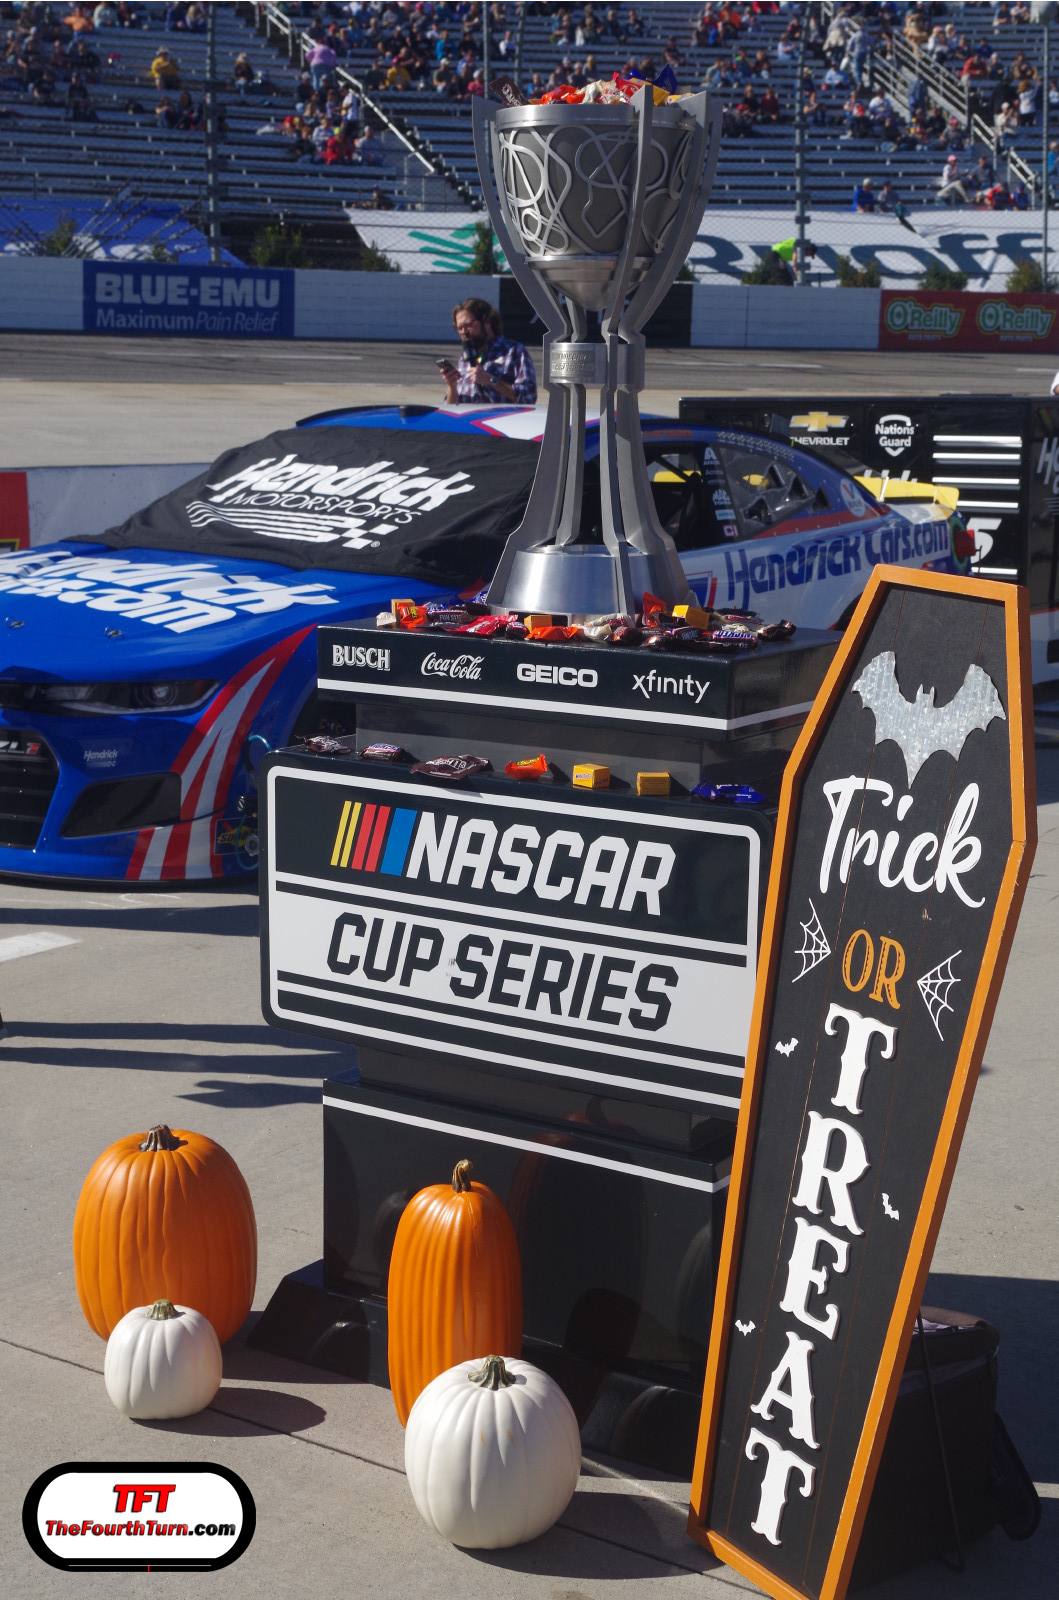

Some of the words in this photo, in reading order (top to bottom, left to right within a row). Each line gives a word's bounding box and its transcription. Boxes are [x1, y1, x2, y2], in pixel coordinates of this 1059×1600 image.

[95, 273, 280, 308] BLUE-EMU
[96, 309, 193, 330] Maximum
[195, 311, 232, 331] Pain
[234, 312, 279, 332] Relief
[889, 303, 961, 333] O'Reilly
[982, 304, 1053, 335] O'Reilly
[875, 424, 914, 435] Nations
[879, 436, 911, 447] Guard
[206, 454, 475, 511] Hendrick
[230, 493, 421, 524] MOTORSPORTS
[332, 644, 391, 672] BUSCH
[420, 651, 485, 680] Coca-Cola
[516, 663, 598, 688] GEICO
[632, 669, 710, 703] xfinity
[84, 749, 118, 762] Hendrick
[819, 775, 985, 908] Trick
[406, 811, 676, 916] NASCAR
[327, 912, 445, 987] CUP
[449, 934, 679, 1032] SERIES
[842, 929, 906, 1009] OR
[744, 1002, 898, 1546] TREAT
